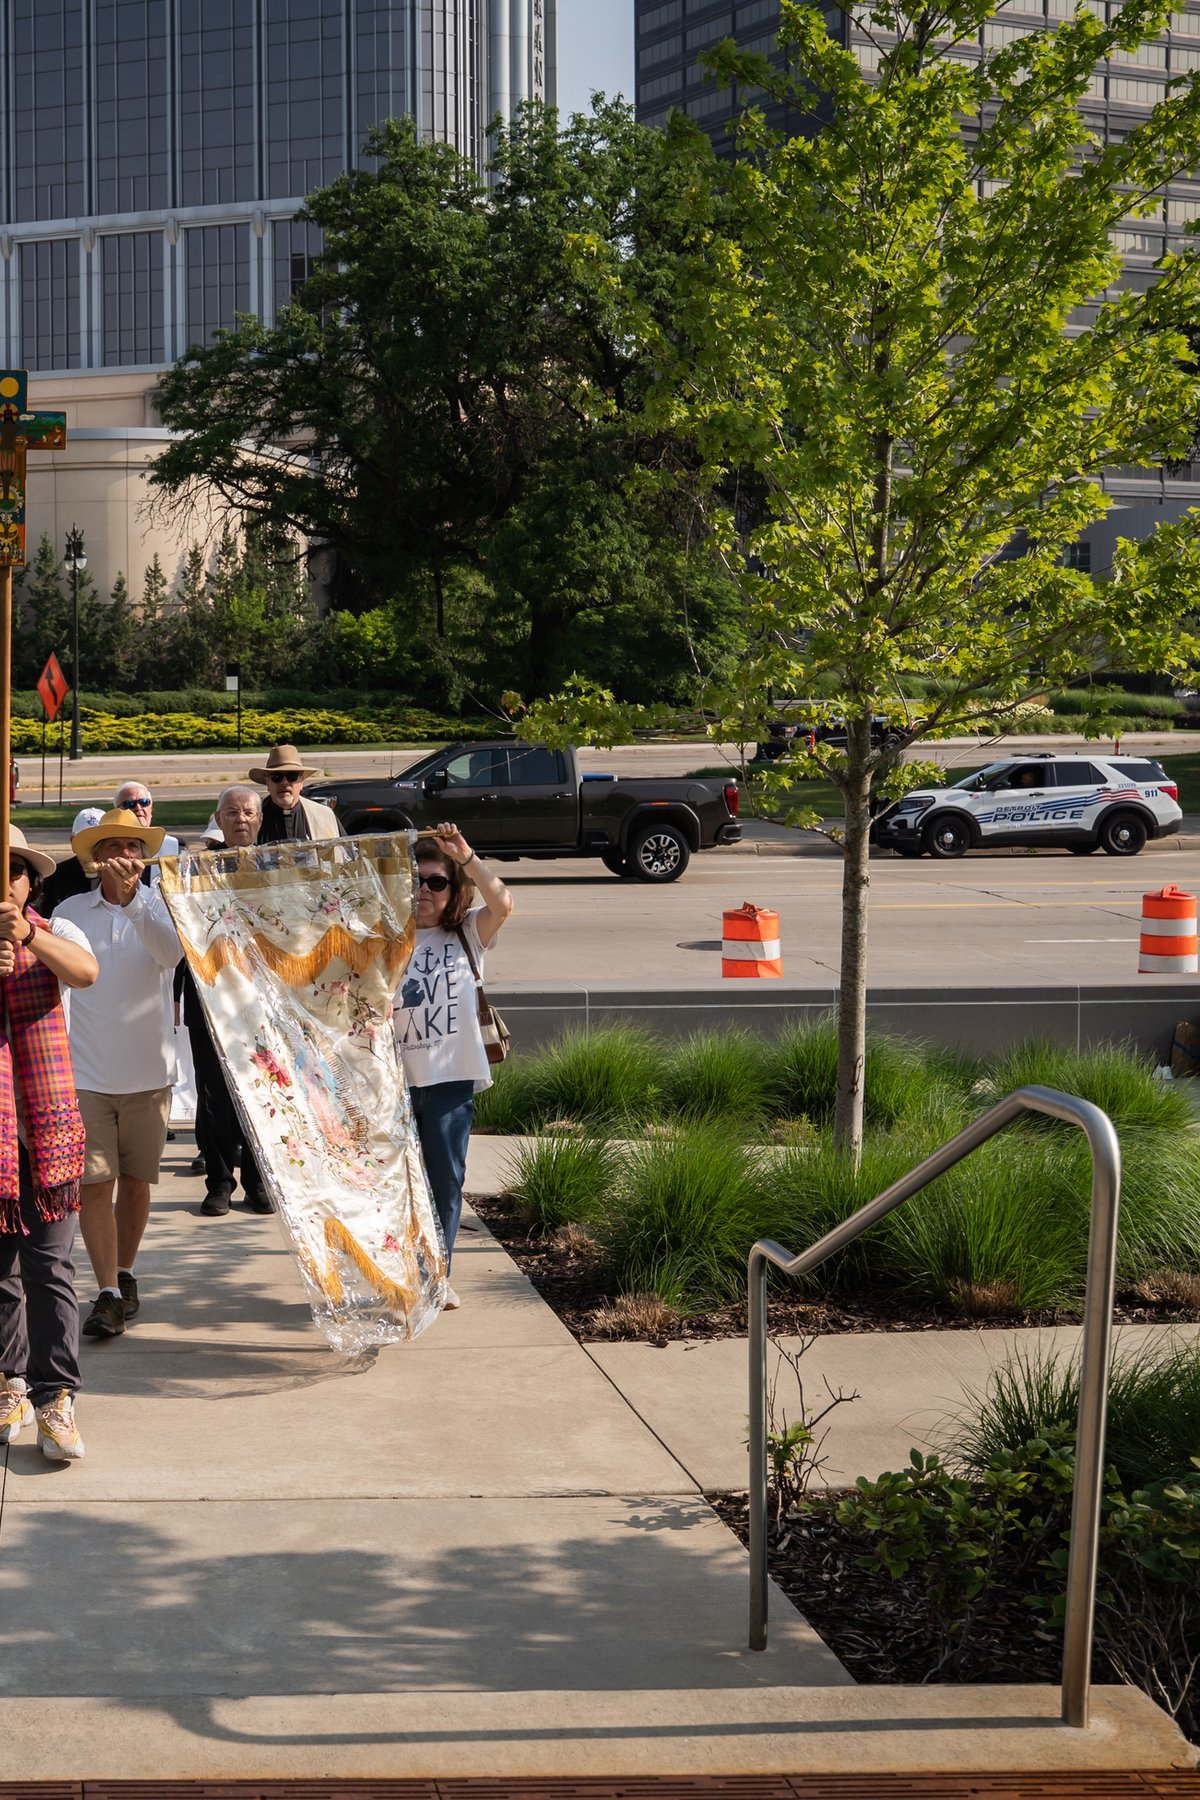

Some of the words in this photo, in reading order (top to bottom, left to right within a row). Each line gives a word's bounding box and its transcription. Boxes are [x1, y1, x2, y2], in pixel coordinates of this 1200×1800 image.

[1144, 789, 1158, 798] 911
[996, 804, 1041, 812] DETROIT
[993, 810, 1084, 822] POLICE
